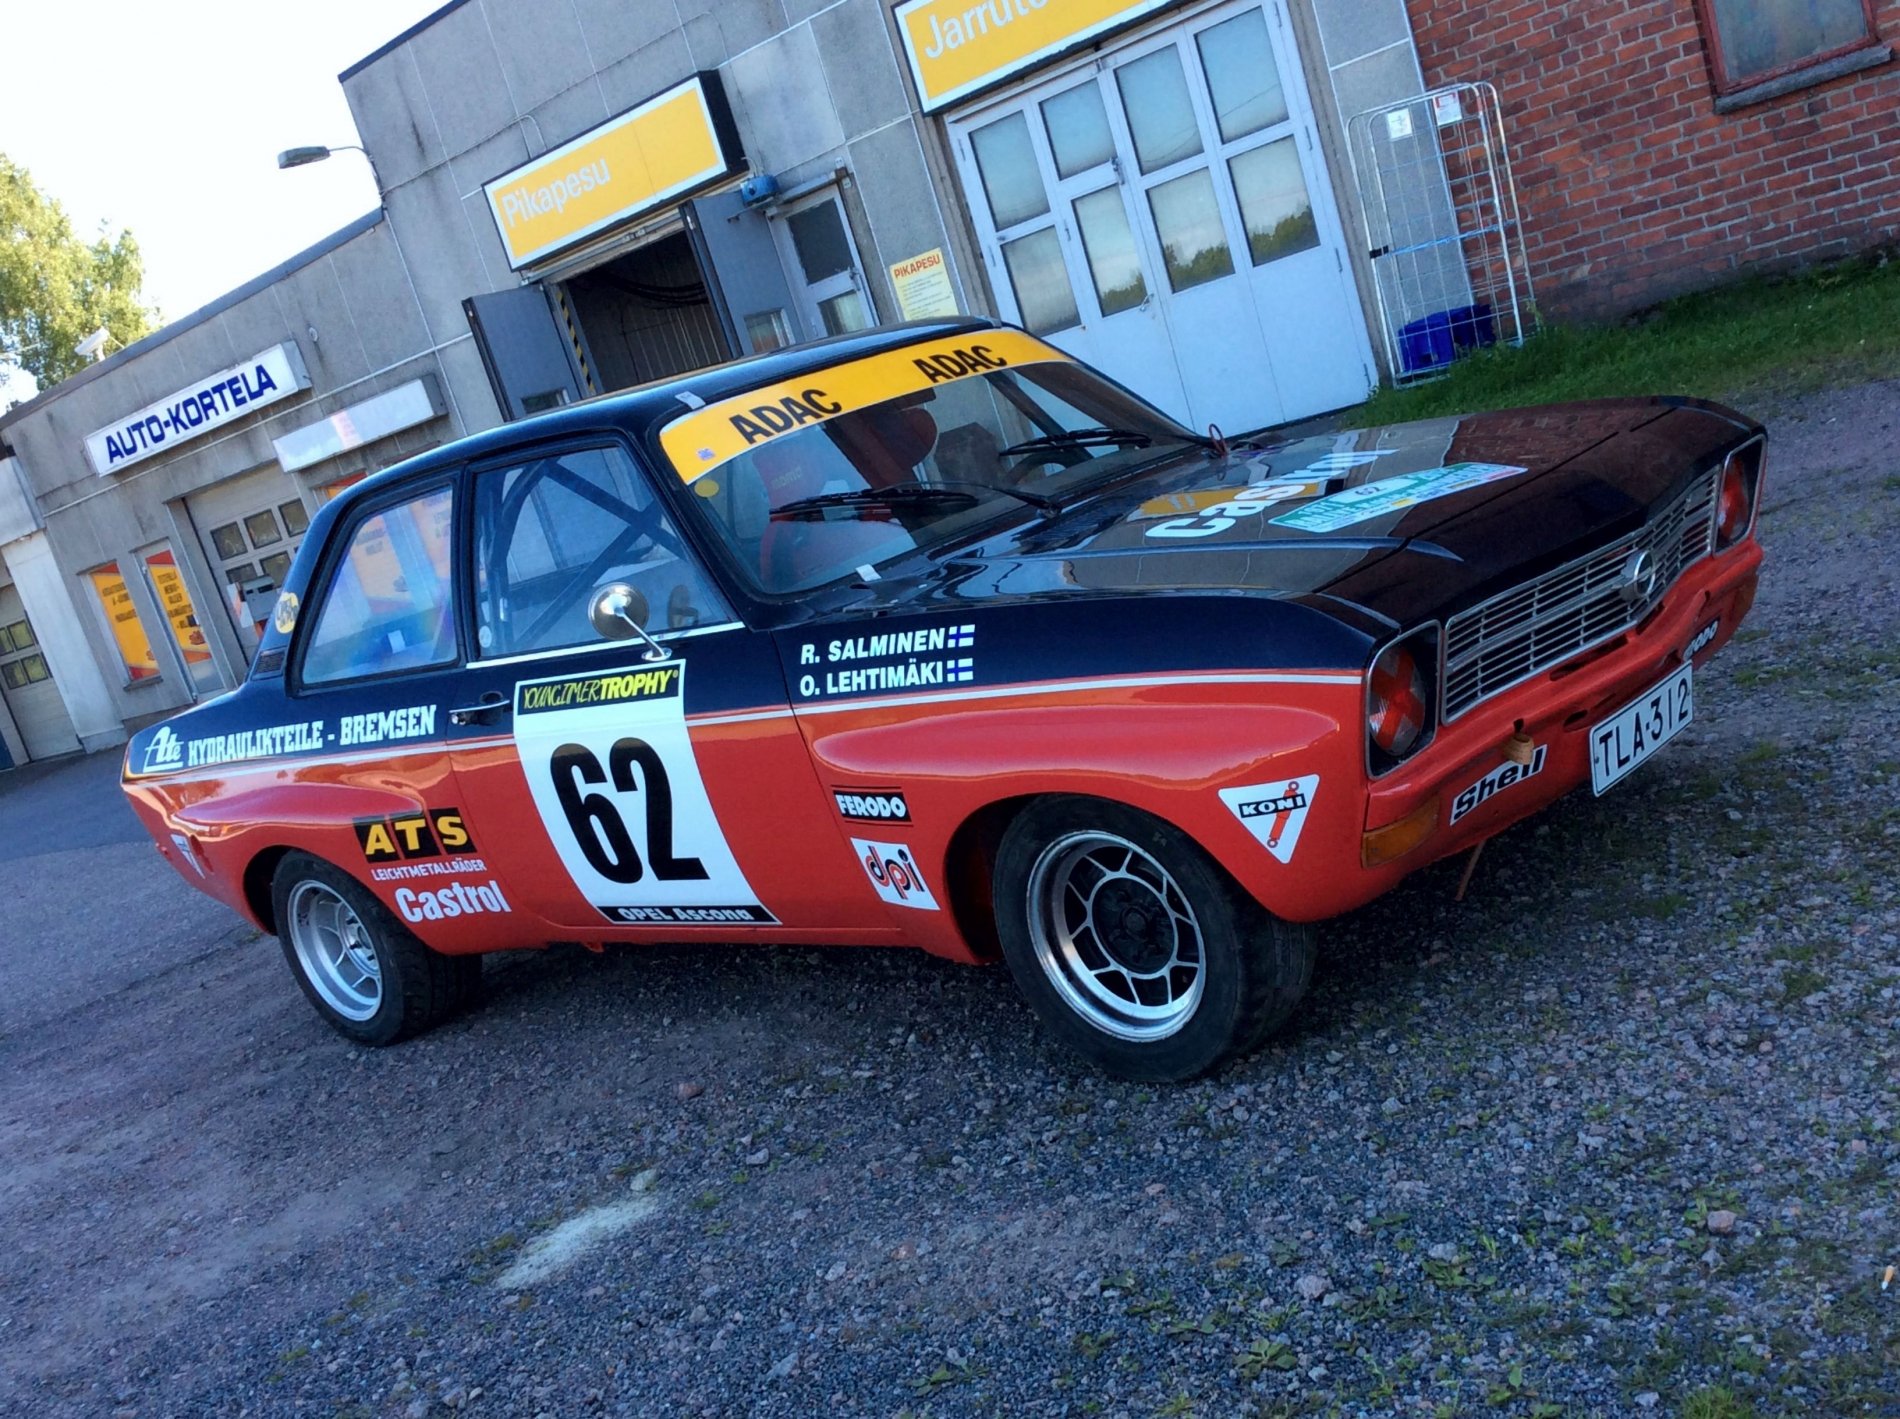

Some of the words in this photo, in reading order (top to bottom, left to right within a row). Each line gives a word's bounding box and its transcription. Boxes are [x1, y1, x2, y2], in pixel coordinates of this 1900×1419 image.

[501, 155, 611, 227] Pikapesu
[893, 253, 941, 279] PIKAPESU
[911, 344, 1008, 383] ADAC
[105, 364, 278, 464] AUTO-KORTELA
[728, 388, 842, 444] ADAC
[800, 644, 821, 665] R.
[828, 627, 945, 662] SALMINEN
[800, 674, 821, 697] O.
[826, 658, 944, 694] LEHTIMÄKI
[187, 721, 324, 767] HYDRAULIKTEILE
[339, 704, 436, 746] BREMSEN
[1599, 677, 1689, 777] TLA-312
[549, 736, 711, 884] 62
[834, 794, 907, 818] FERODO
[1242, 795, 1305, 817] KONI
[364, 814, 472, 856] ATS
[371, 857, 488, 881] LEICHTMETALLRÄDER
[864, 845, 925, 900] dpi
[395, 880, 513, 923] Castrol
[617, 907, 674, 921] OPEL
[672, 907, 755, 921] Ascona
